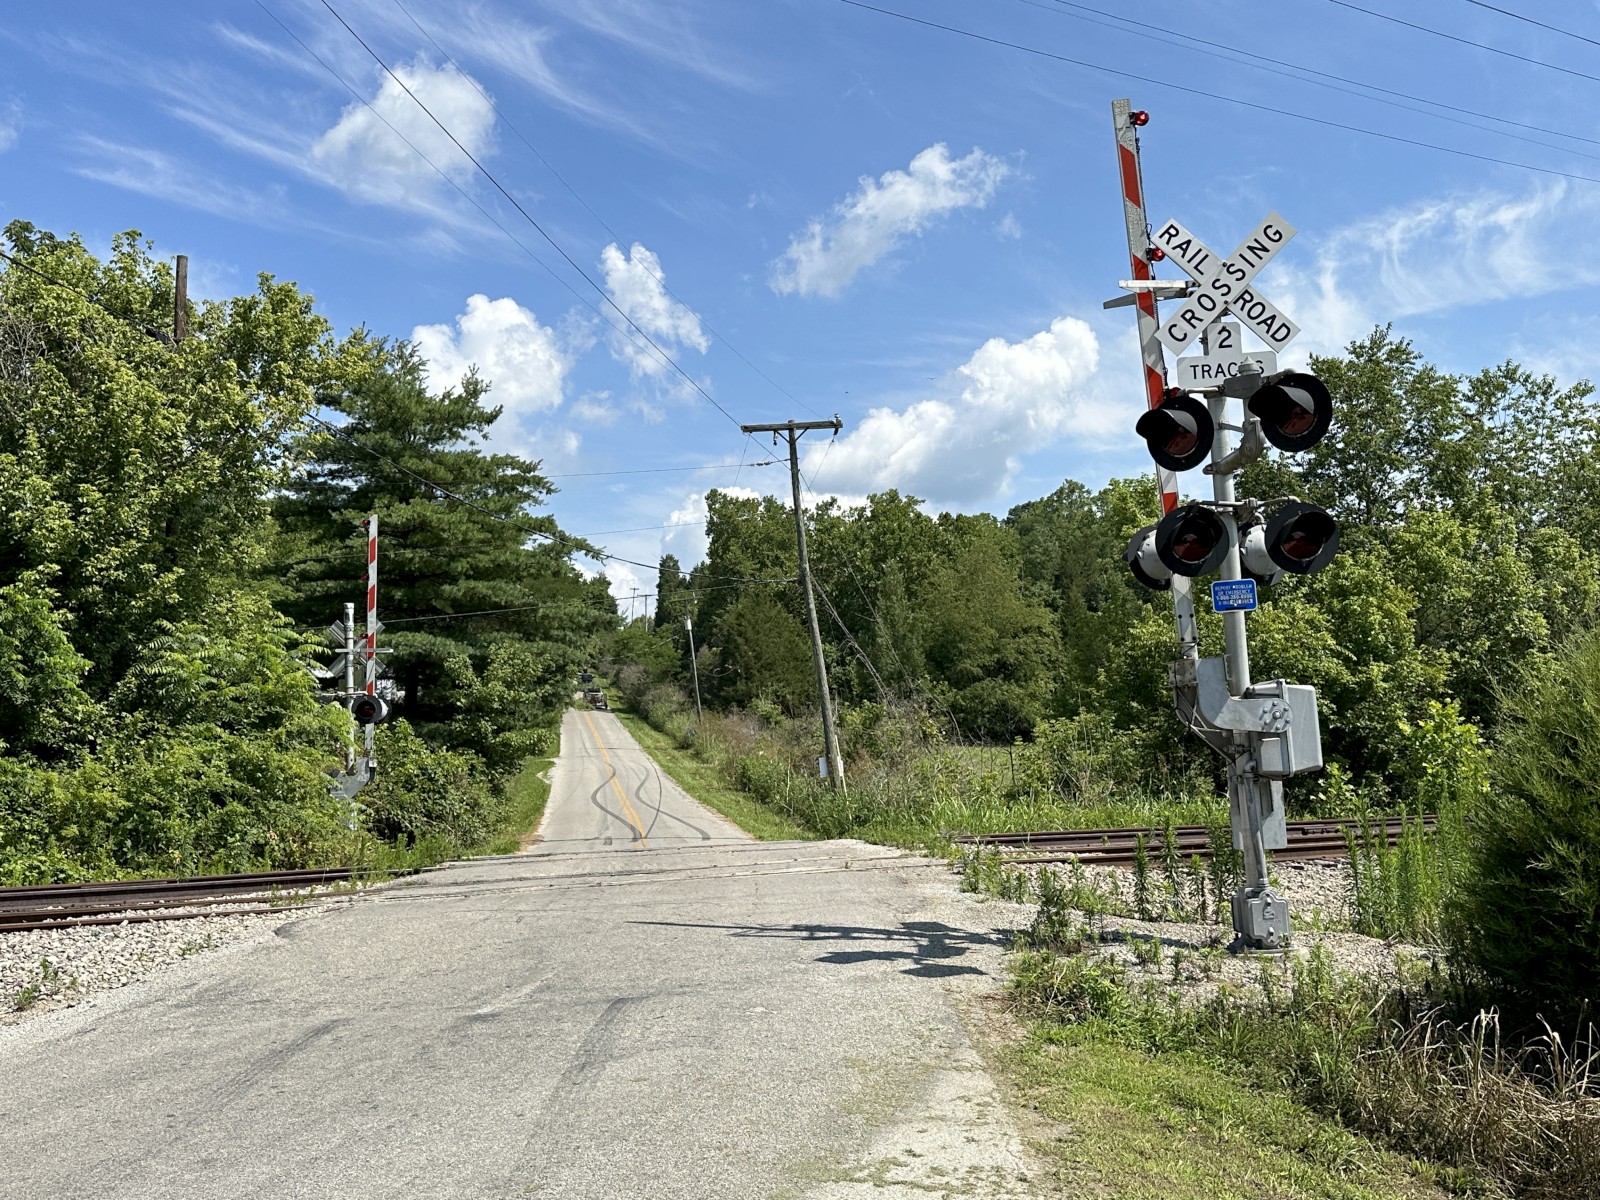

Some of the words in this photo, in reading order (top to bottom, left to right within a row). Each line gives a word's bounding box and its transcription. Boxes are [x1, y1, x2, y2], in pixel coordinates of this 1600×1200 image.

[1158, 223, 1210, 276] RAIL
[1232, 288, 1292, 343] ROAD
[1167, 224, 1283, 343] CROSSING
[1189, 360, 1265, 380] TRACS
[1217, 326, 1233, 349] 2
